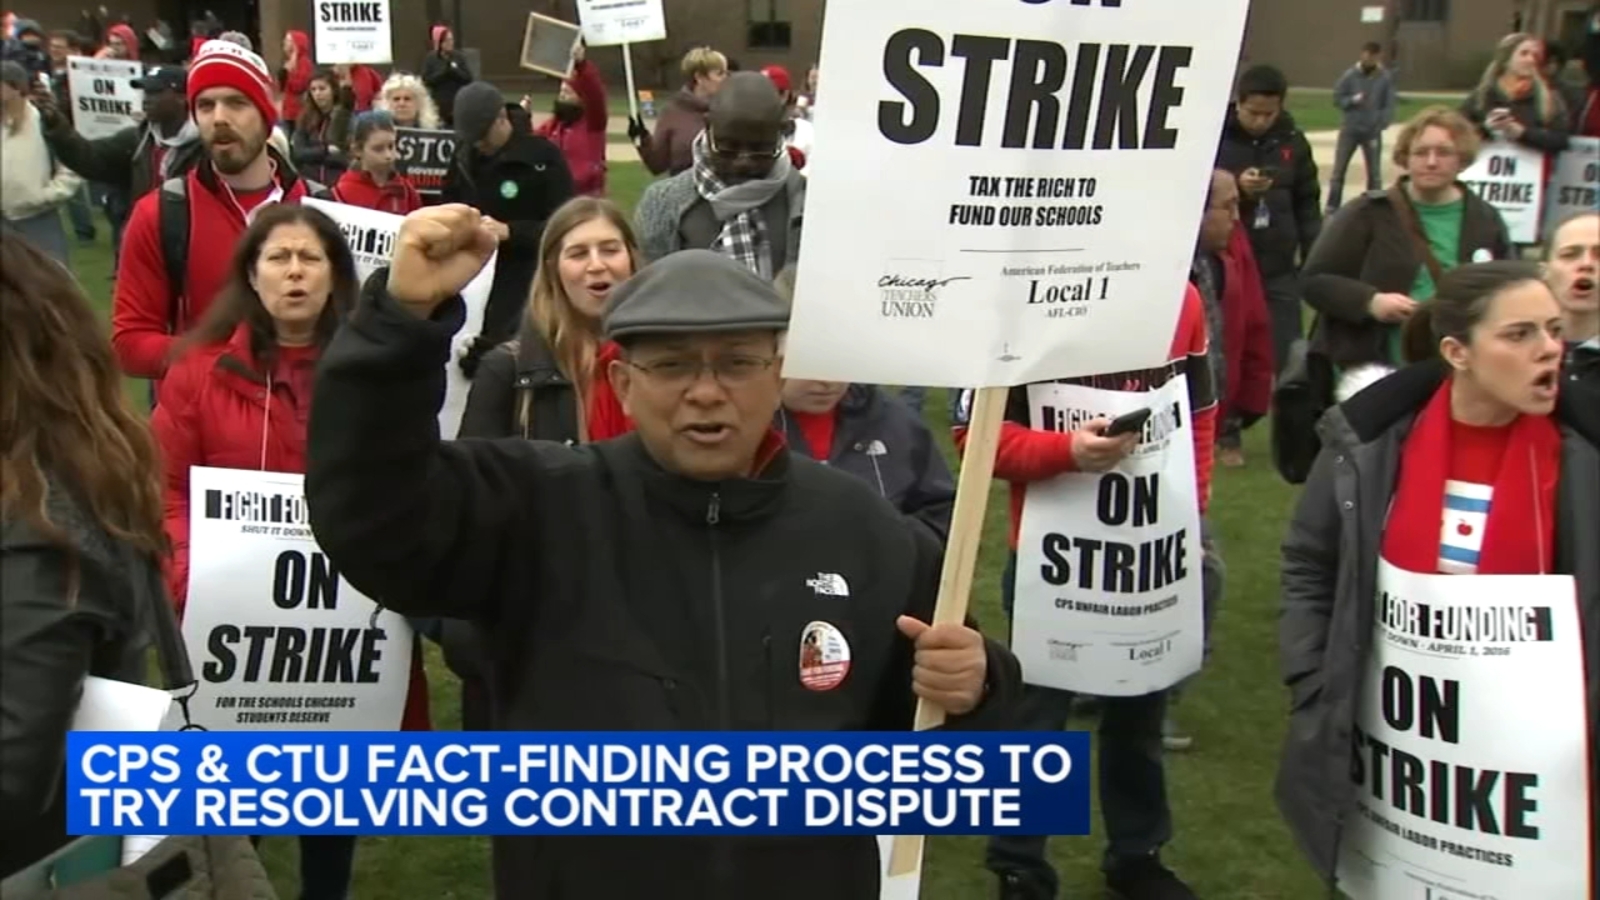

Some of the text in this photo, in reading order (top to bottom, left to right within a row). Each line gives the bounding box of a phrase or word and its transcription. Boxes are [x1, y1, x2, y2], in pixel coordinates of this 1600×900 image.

[320, 2, 383, 22] STRIKE
[94, 79, 115, 95] ON
[877, 27, 1194, 150] STRIKE
[1488, 155, 1516, 176] ON
[1584, 163, 1599, 182] O
[969, 176, 1096, 198] TAX THE RICH TO
[949, 204, 1103, 226] FUND OUR SCHOOLS
[1001, 267, 1046, 276] American
[878, 275, 972, 292] Chicago
[1027, 276, 1109, 304] Local 1
[882, 301, 934, 317] UNION
[1096, 472, 1159, 527] ON
[1040, 528, 1188, 594] STRIKE
[272, 550, 340, 610] ON
[1055, 598, 1074, 611] CPS
[1076, 601, 1109, 615] UNFAIR
[1111, 605, 1142, 616] LABOR
[1430, 605, 1538, 641] FUNDING
[202, 624, 388, 683] STRIKE
[1129, 640, 1164, 661] Local
[1427, 643, 1467, 655] APRIL
[1482, 647, 1511, 656] 2016
[215, 697, 236, 708] FOR
[237, 697, 257, 708] THE
[258, 697, 302, 708] SCHOOLS
[1381, 665, 1460, 745] ON
[236, 712, 331, 723] STUDENTS DESERVE
[1350, 722, 1540, 840] STRIKE
[1402, 829, 1438, 850] LABOR
[1440, 840, 1513, 867] PRACTICES
